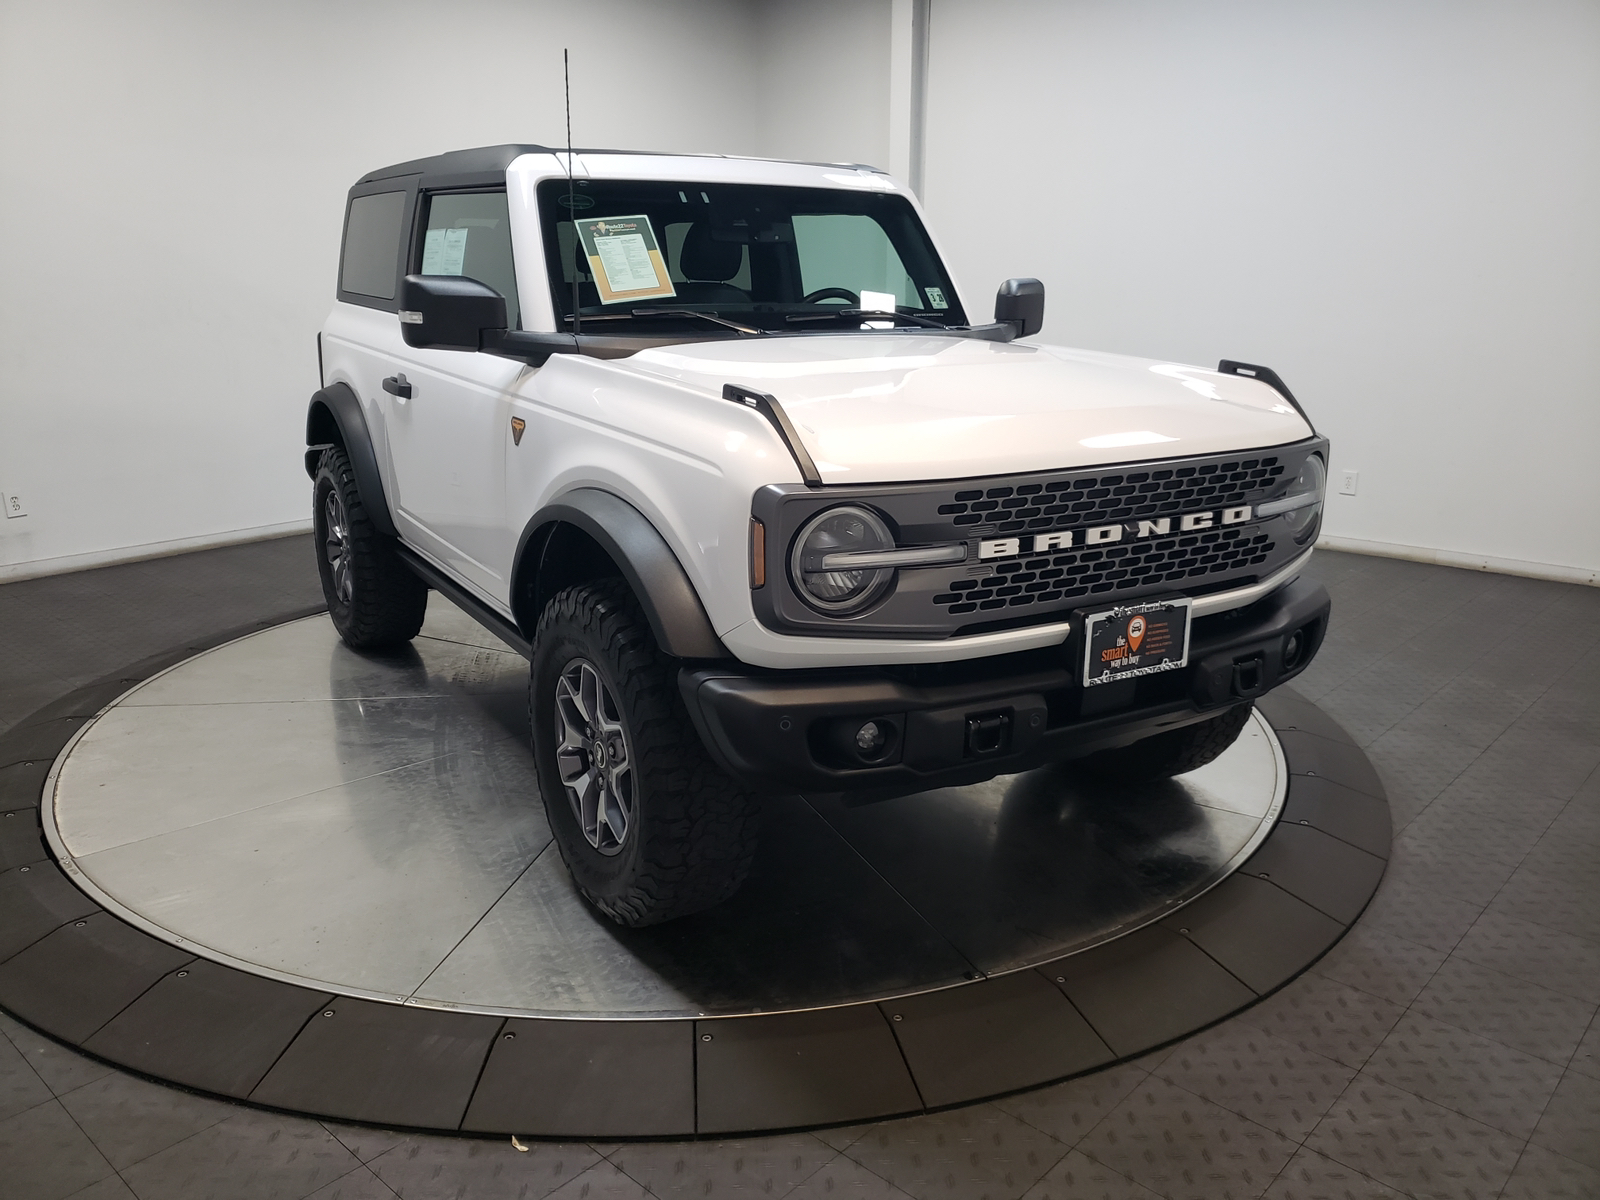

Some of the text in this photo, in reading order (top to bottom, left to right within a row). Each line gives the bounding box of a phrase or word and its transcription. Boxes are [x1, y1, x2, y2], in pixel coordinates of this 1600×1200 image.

[978, 505, 1252, 559] BRONCO
[1116, 635, 1126, 647] the
[1101, 643, 1128, 661] smart
[1110, 653, 1141, 669] way to buy
